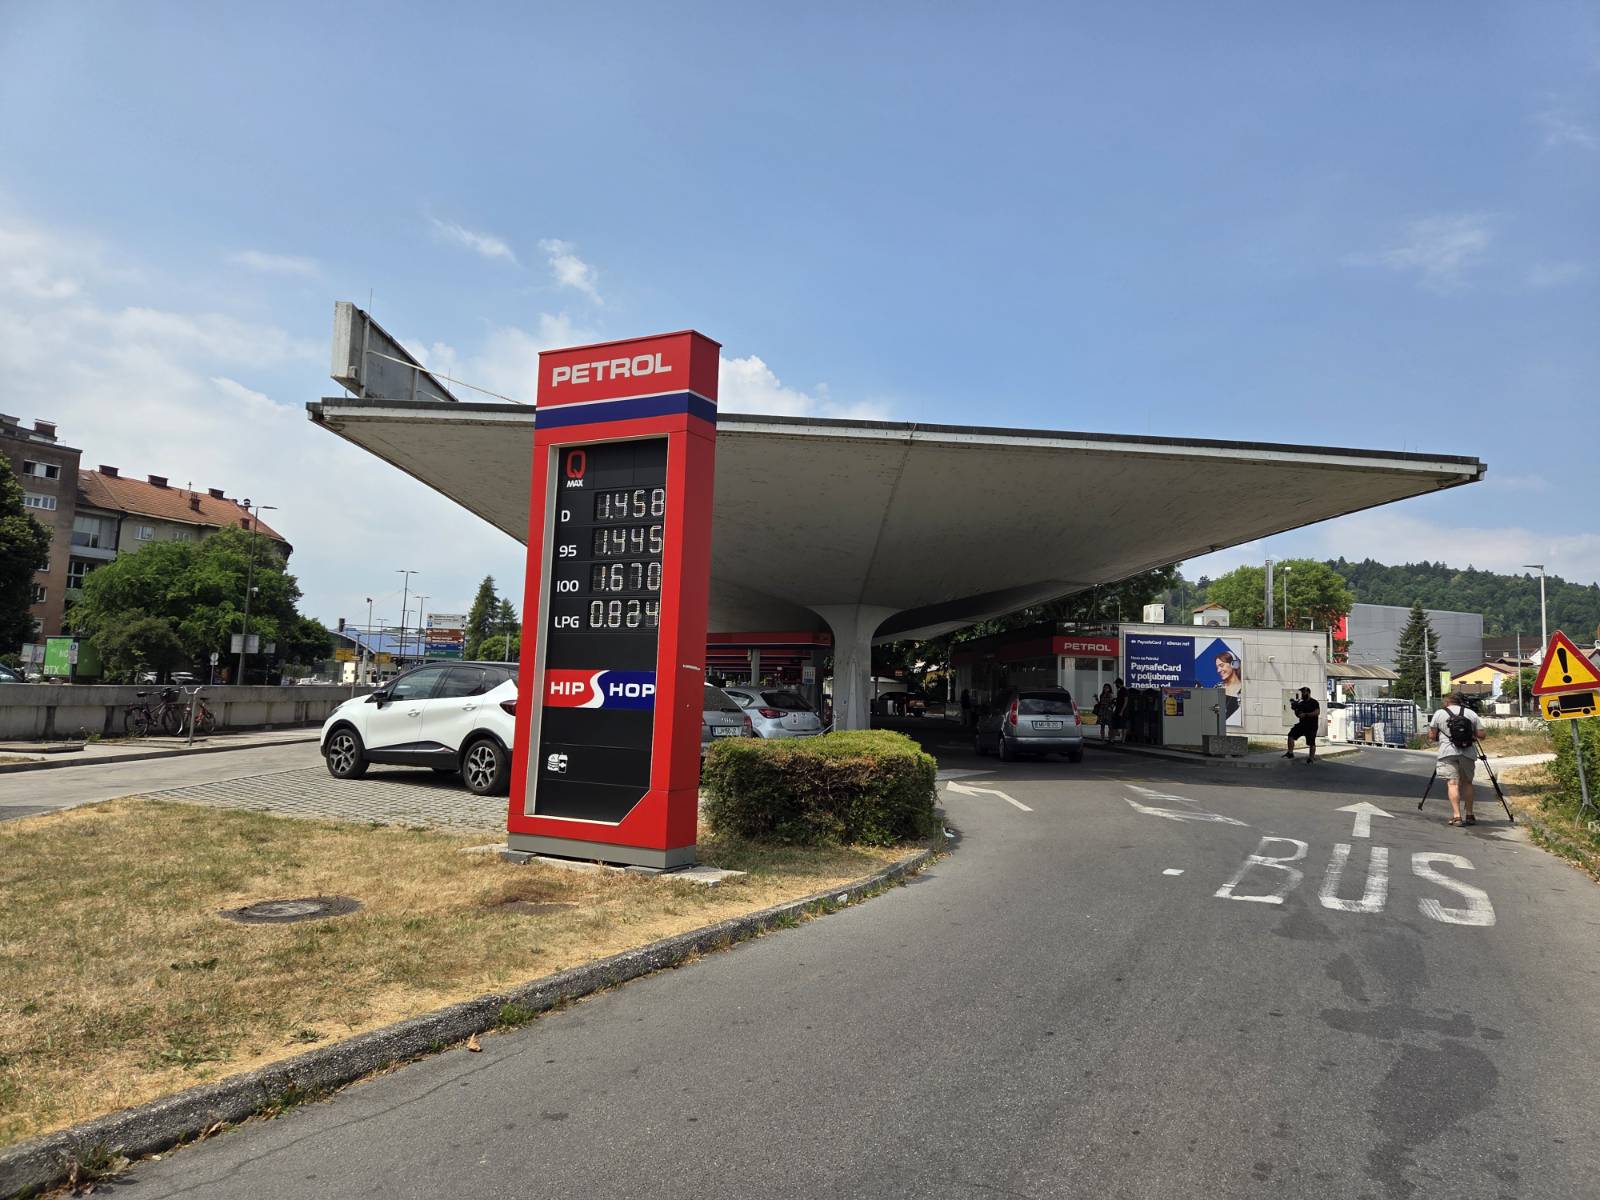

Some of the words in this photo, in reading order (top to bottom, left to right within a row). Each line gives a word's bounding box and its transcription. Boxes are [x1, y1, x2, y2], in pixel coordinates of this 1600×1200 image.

[552, 353, 672, 387] PETROL
[567, 450, 586, 478] Q
[566, 479, 584, 488] MAX
[561, 510, 571, 522] D
[559, 545, 577, 558] 95
[556, 580, 580, 593] 100
[554, 616, 580, 628] LPG
[1064, 642, 1111, 652] PETROL
[1131, 662, 1181, 672] PaysafeCard
[1137, 672, 1179, 681] poljubnem
[550, 681, 585, 696] HIP
[1214, 836, 1497, 927] BUS
